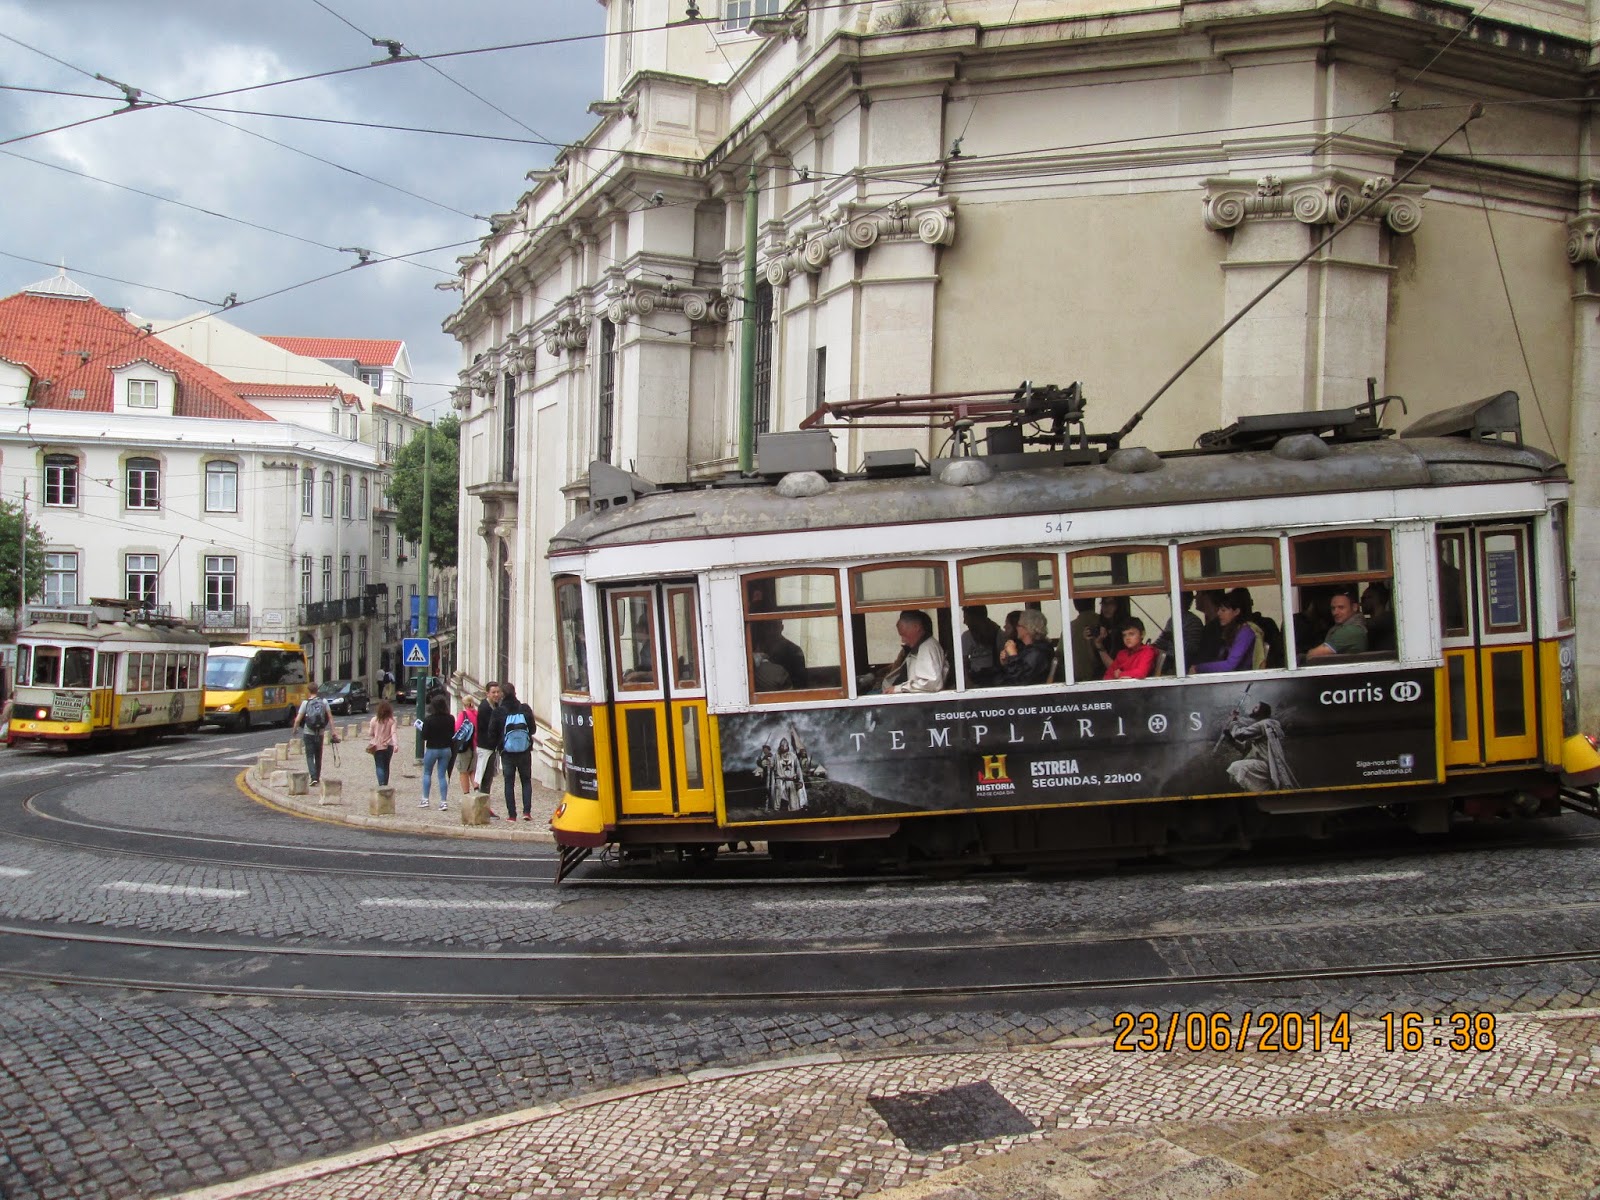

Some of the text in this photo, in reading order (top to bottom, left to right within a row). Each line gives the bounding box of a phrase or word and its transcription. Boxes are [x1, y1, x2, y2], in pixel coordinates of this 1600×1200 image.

[1045, 521, 1073, 533] 547
[1320, 682, 1383, 705] carris
[55, 700, 82, 708] DUBLIN
[935, 702, 1112, 721] ESQUEÇA TUDO O QUE JULGAVA SABER
[849, 711, 1203, 752] TEMPLÁRIOS
[982, 754, 1009, 780] H
[1030, 759, 1079, 777] ESTREIA
[1356, 760, 1385, 768] Siga-nos
[1363, 768, 1412, 776] canalhistoria.pt
[976, 782, 1016, 792] HISTORIA
[1032, 773, 1142, 789] SEGUNDAS, 22h00
